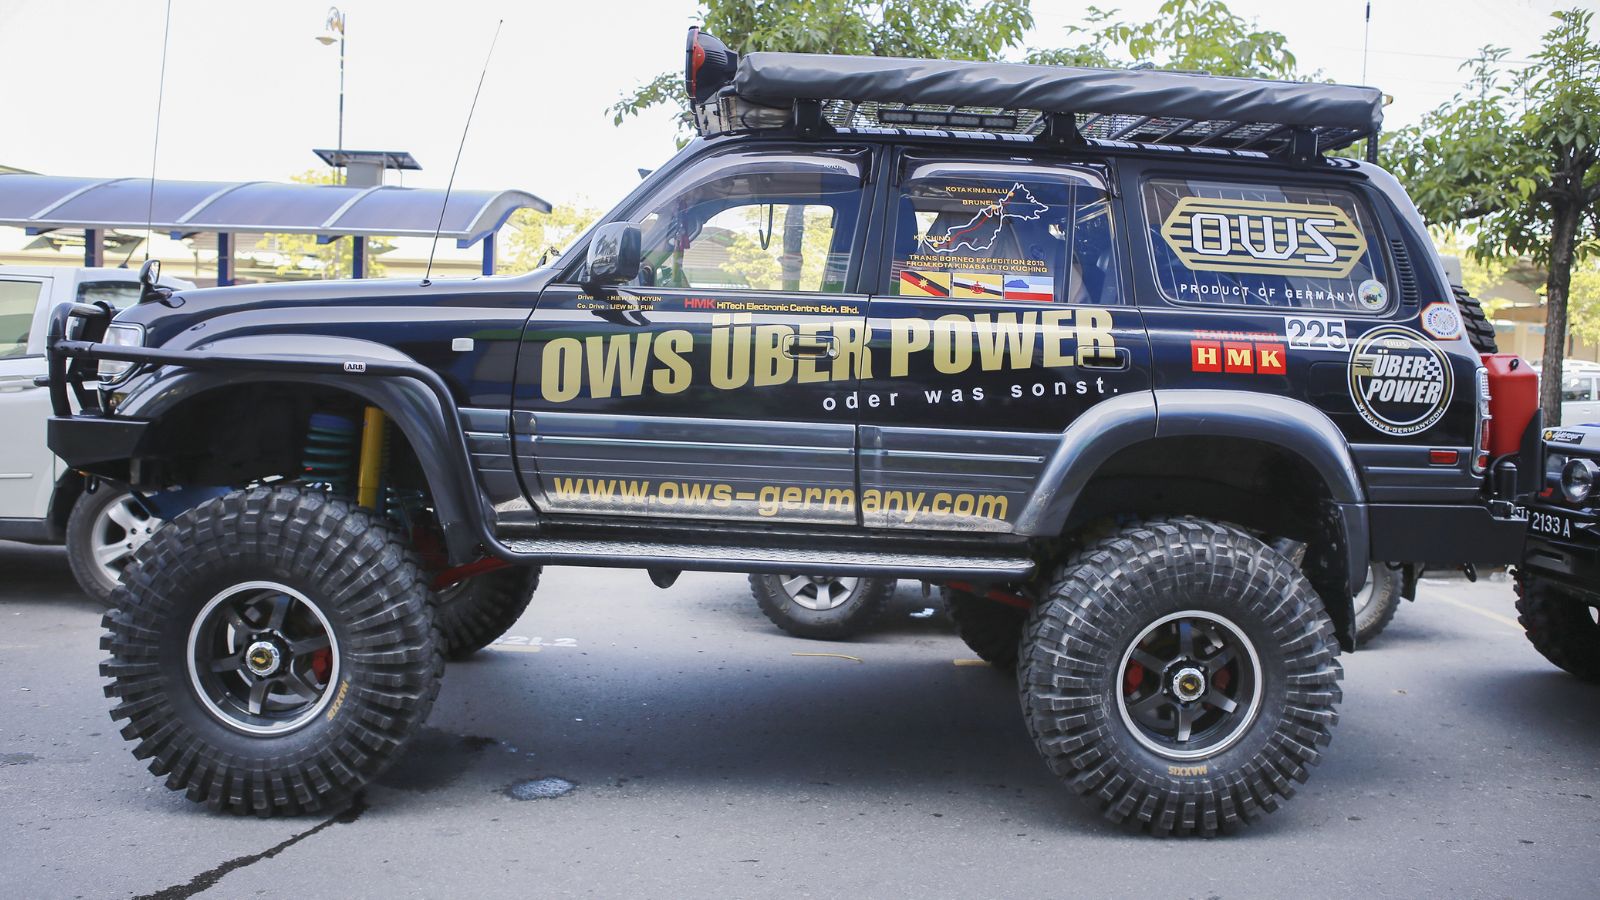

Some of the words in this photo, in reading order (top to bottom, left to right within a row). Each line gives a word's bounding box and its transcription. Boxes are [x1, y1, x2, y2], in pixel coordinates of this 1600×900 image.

[1191, 212, 1338, 263] OWS
[939, 255, 974, 263] BORNEO
[976, 257, 1025, 265] EXPEDITION
[684, 298, 715, 309] HMK
[746, 302, 789, 312] Electronic
[789, 304, 819, 313] Centre
[820, 305, 839, 313] Sdn.
[841, 306, 860, 314] Bhd.
[1180, 284, 1249, 296] PRODUCT
[1258, 287, 1275, 297] OF
[1286, 289, 1354, 302] GERMANY
[1288, 319, 1347, 349] 225
[541, 329, 694, 403] OWS
[710, 312, 873, 390] ÜBER
[890, 309, 1116, 377] POWER
[1197, 347, 1282, 367] HMK
[1372, 348, 1427, 378] ÜBER
[822, 391, 899, 411] oder
[924, 386, 985, 404] was
[1010, 376, 1119, 398] sonst.
[1366, 378, 1442, 404] POWER
[553, 477, 1009, 524] www.ows-germany.com
[1532, 511, 1560, 534] 2133
[1562, 518, 1571, 538] A
[1167, 765, 1208, 777] MAXXIS
